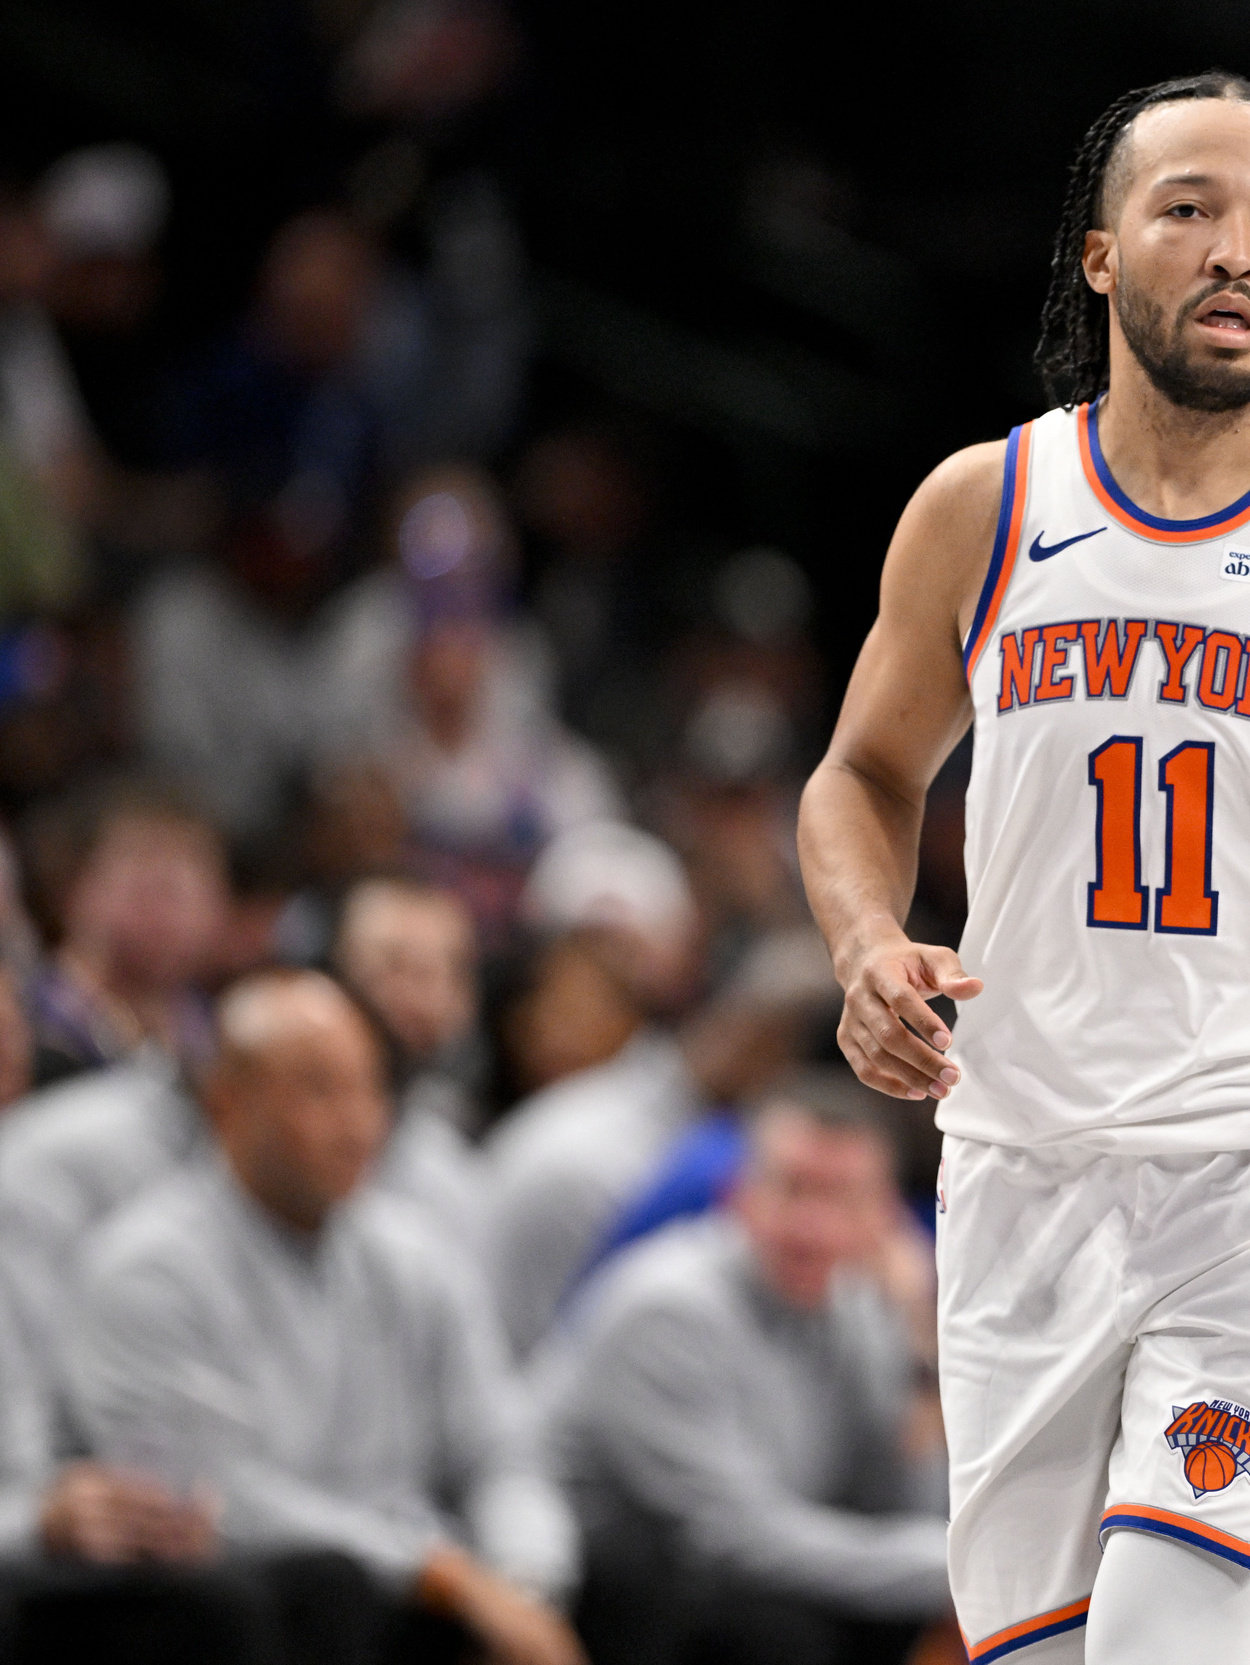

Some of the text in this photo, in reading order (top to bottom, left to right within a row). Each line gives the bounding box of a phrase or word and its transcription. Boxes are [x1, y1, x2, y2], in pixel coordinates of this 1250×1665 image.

[997, 616, 1149, 717] NEW
[1086, 734, 1219, 936] 11
[1209, 1399, 1234, 1412] NEW
